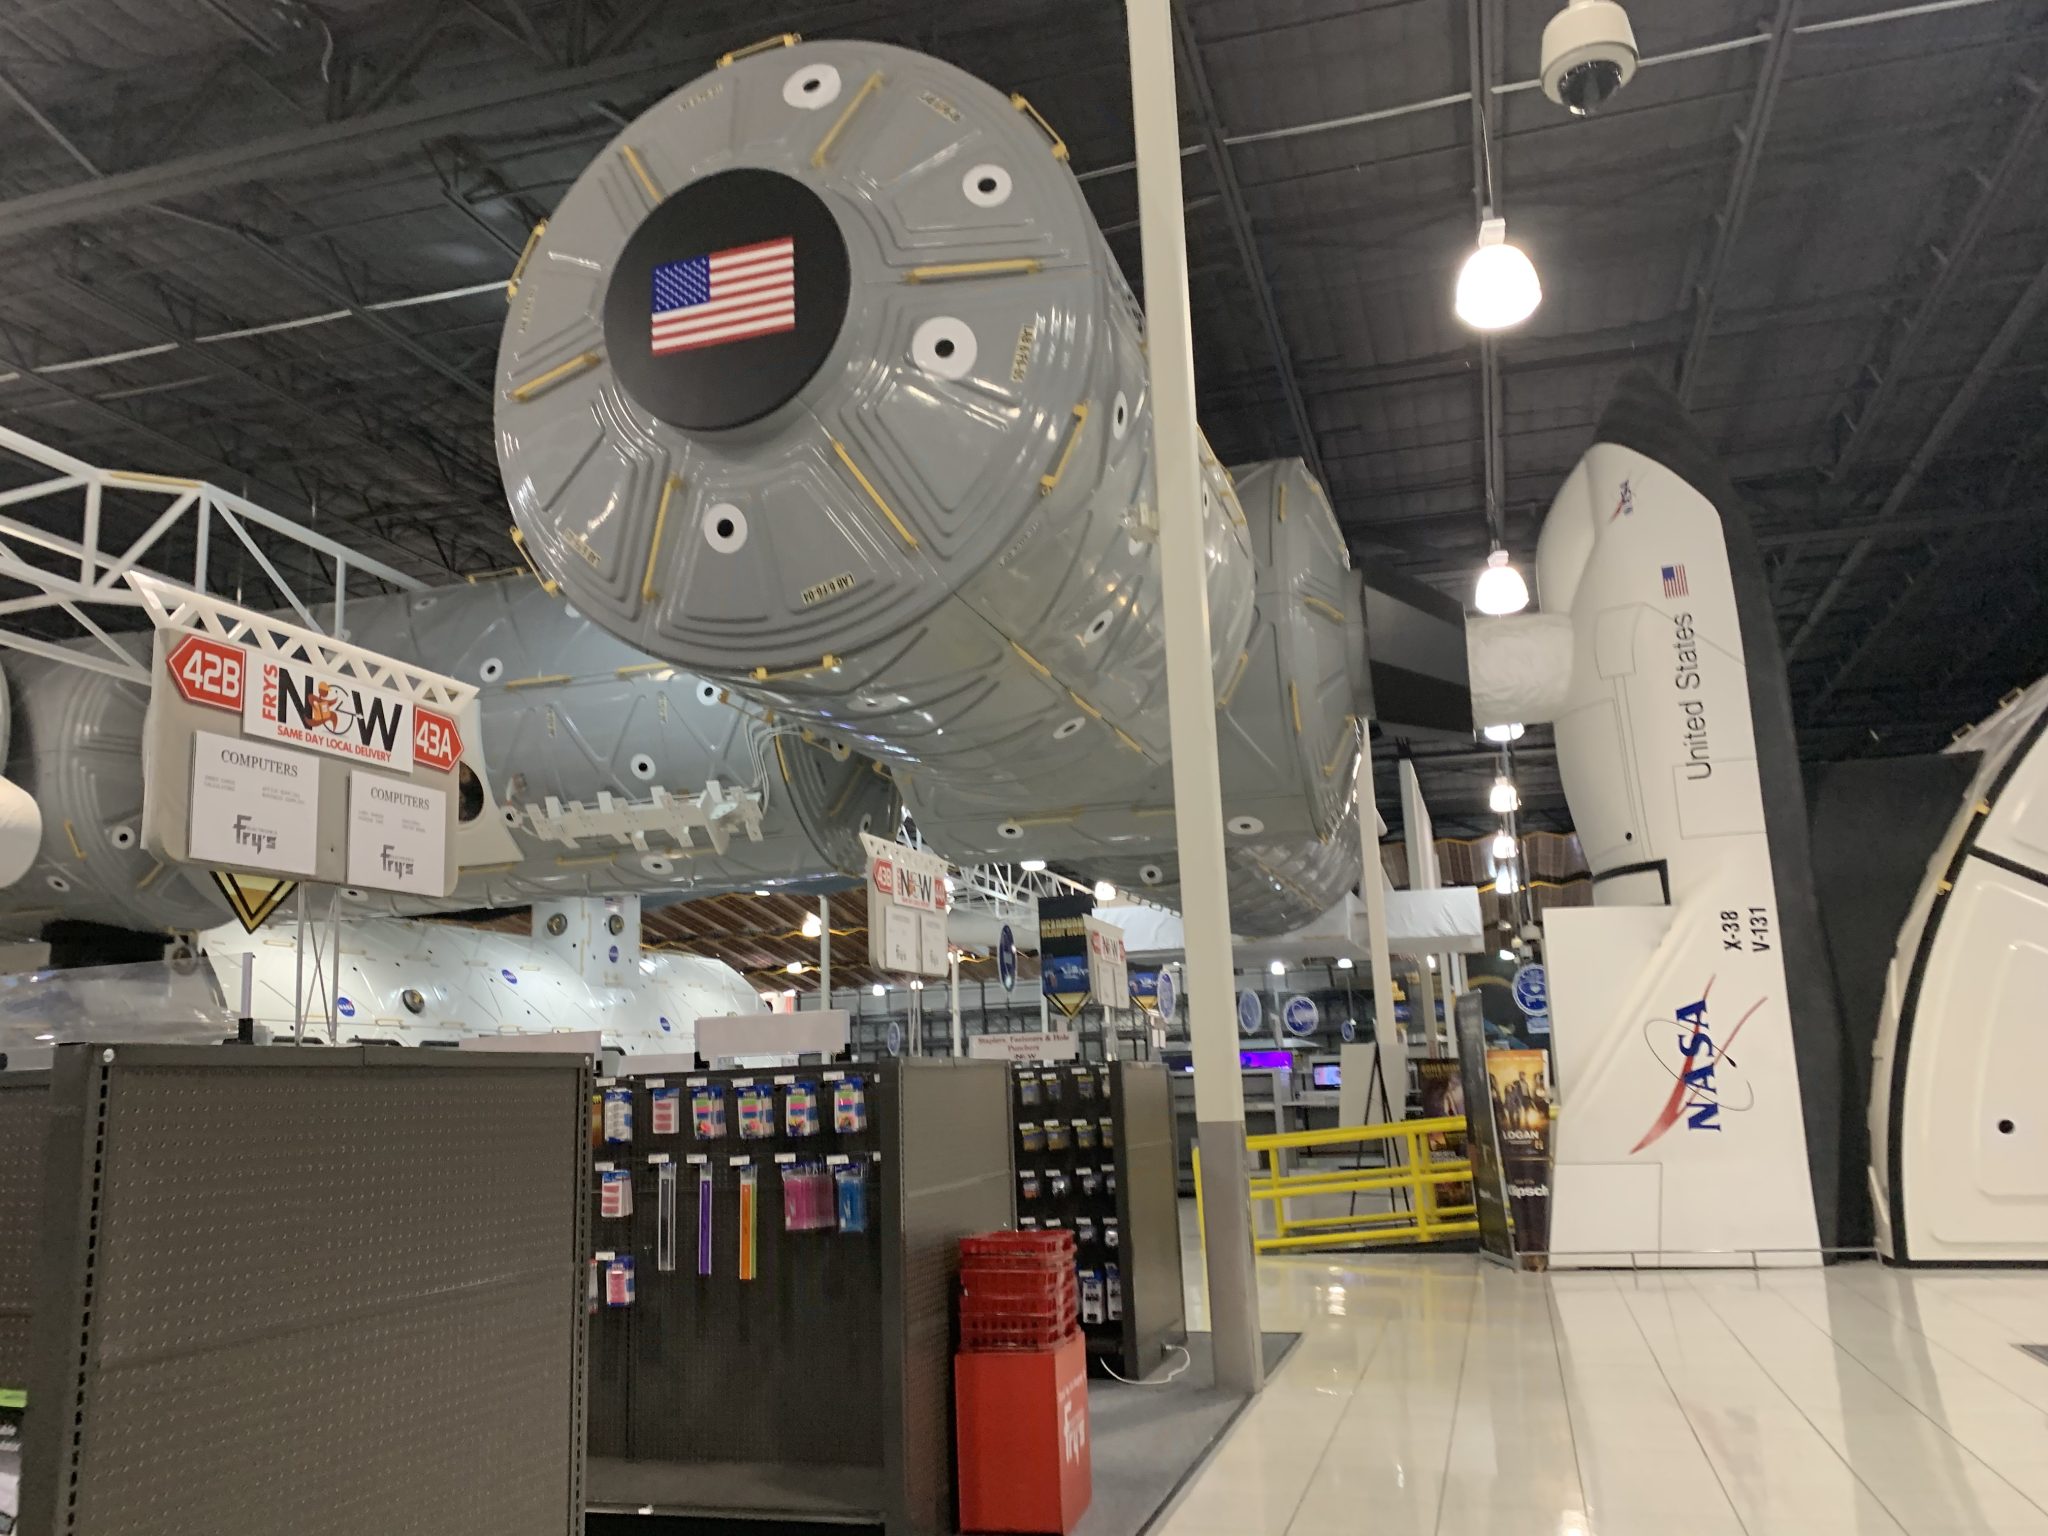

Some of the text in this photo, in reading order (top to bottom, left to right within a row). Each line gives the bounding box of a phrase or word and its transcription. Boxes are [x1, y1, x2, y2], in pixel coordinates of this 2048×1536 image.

[183, 649, 241, 698] 42B
[262, 664, 278, 721] FRYS
[1674, 612, 1712, 780] United States
[277, 725, 391, 763] SAME DAY LOCAL DELIVERY
[416, 721, 452, 762] 43A
[221, 748, 298, 778] COMPUTERS
[370, 786, 430, 811] COMPUTERS
[1720, 910, 1743, 951] X-38
[1748, 907, 1771, 952] V-131
[1675, 999, 1722, 1132] NASA
[1502, 1129, 1540, 1140] LOGAN
